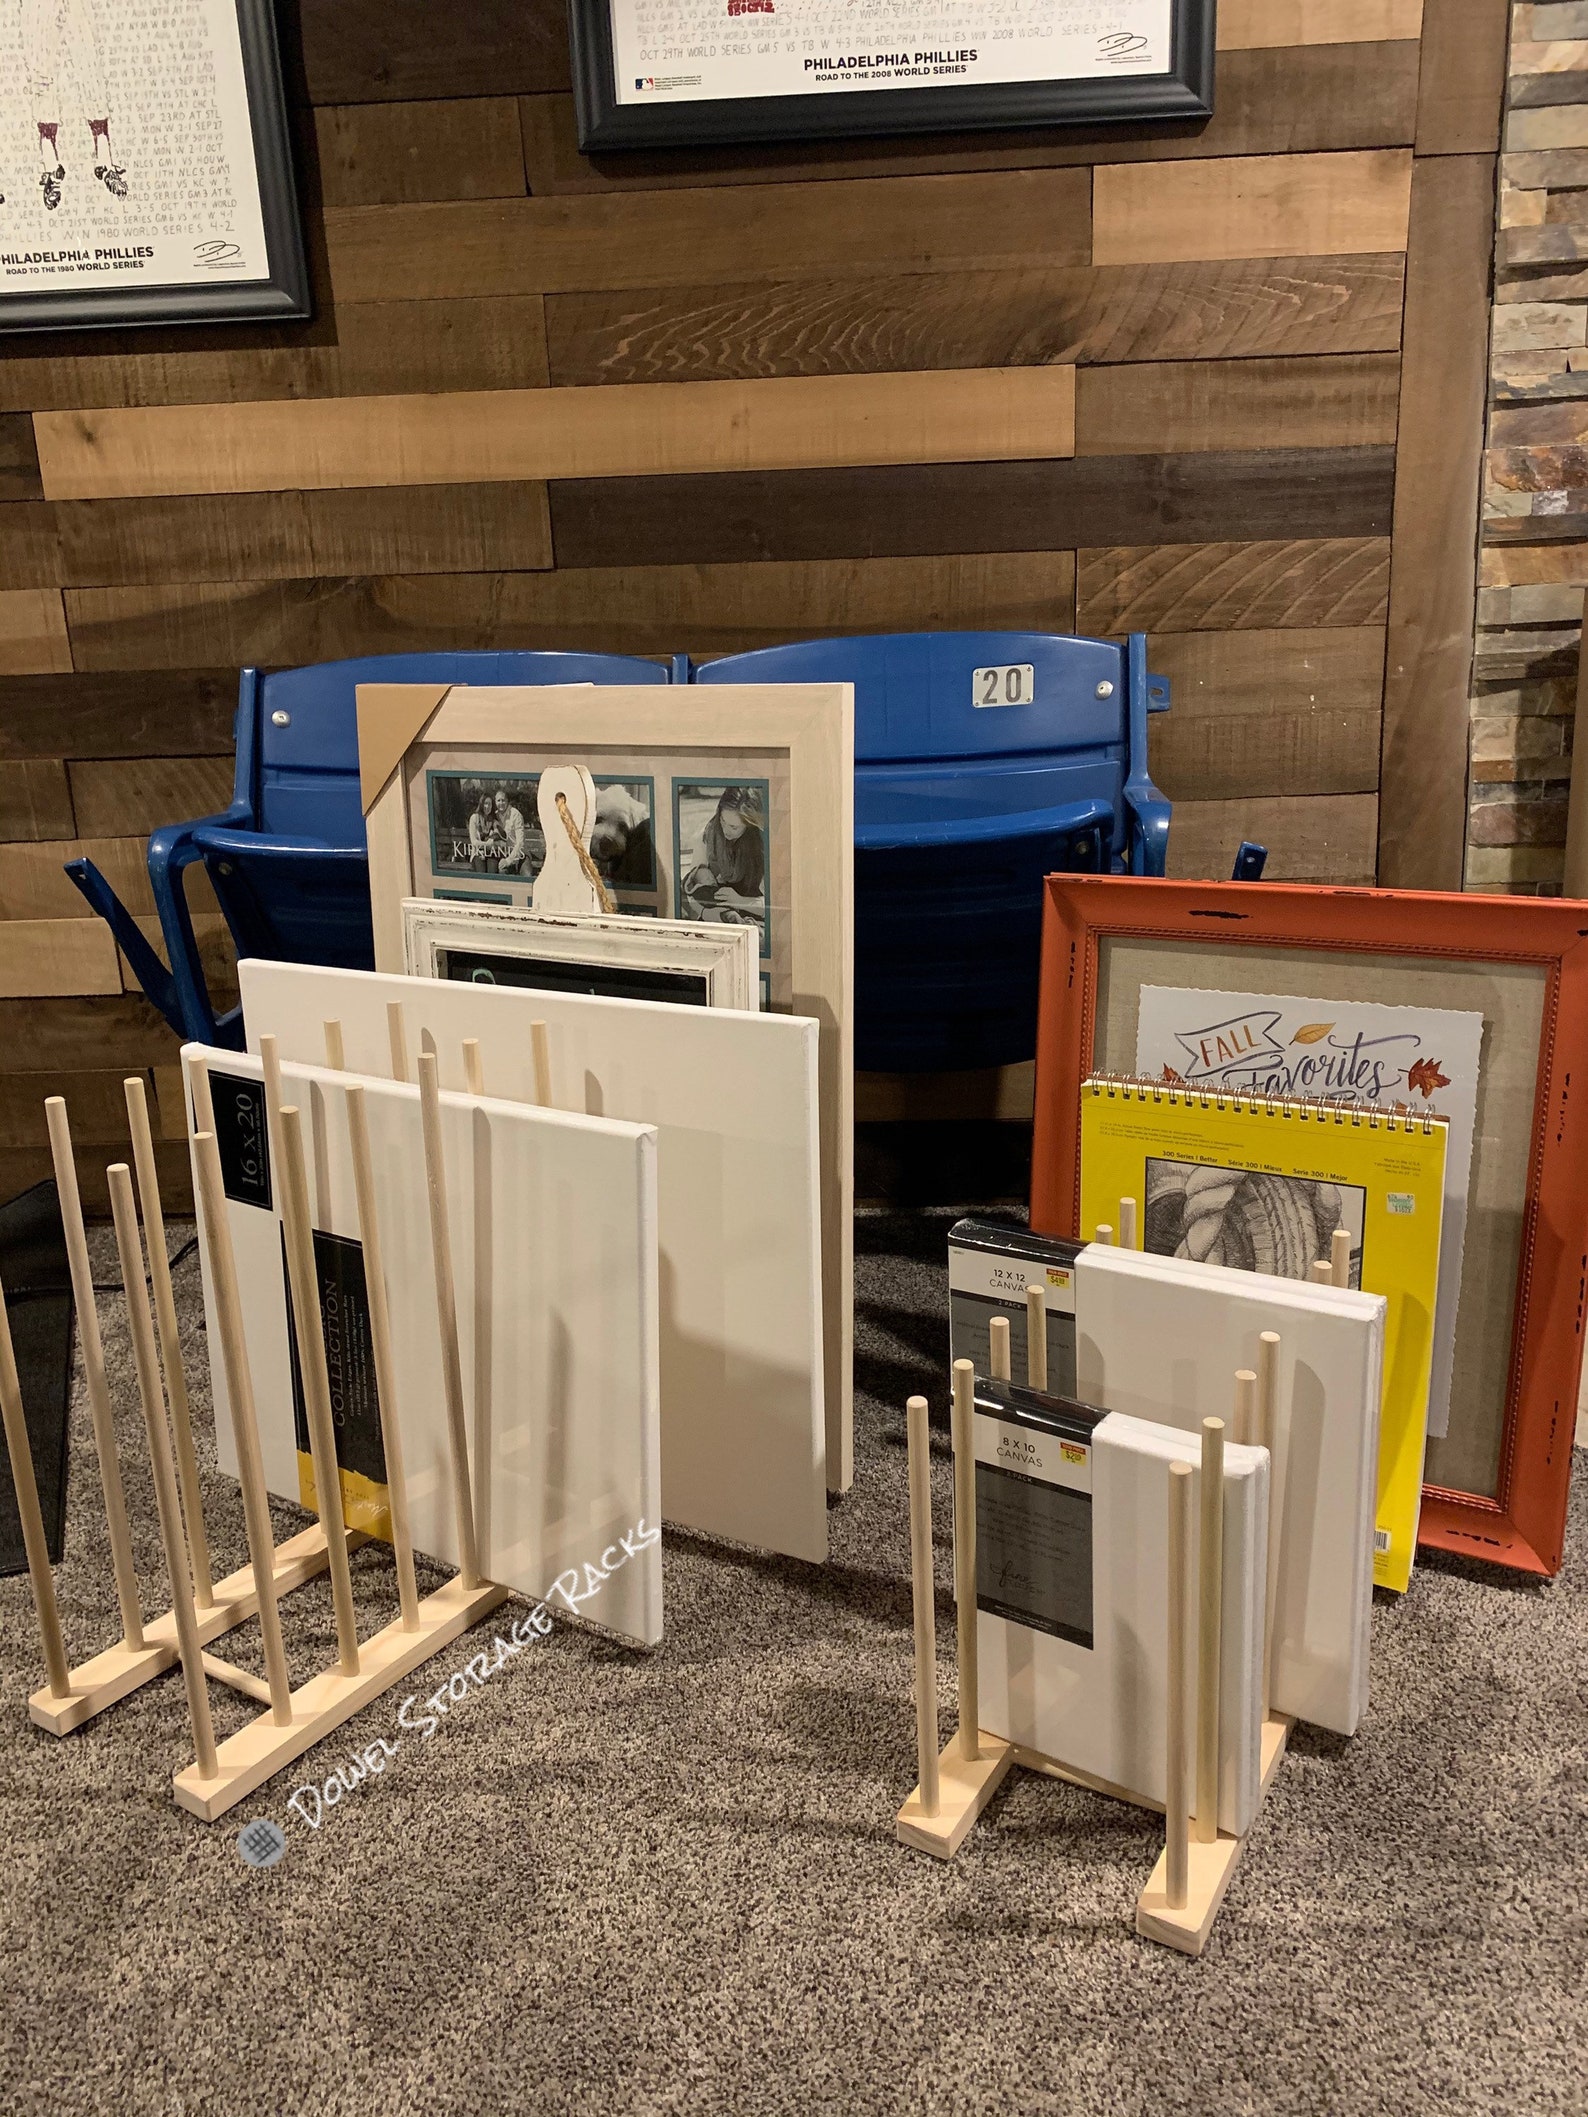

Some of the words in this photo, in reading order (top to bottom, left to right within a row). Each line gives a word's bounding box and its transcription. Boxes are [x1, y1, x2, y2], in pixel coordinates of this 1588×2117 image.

[639, 49, 659, 61] OCT
[662, 47, 684, 60] 29TH
[686, 45, 716, 59] WORLD
[721, 43, 751, 56] SERIES
[785, 41, 796, 53] VS
[855, 33, 918, 47] PHILADELPHIA
[922, 31, 967, 44] PHILLIES
[992, 28, 1014, 41] 2008
[804, 52, 911, 71] PHILADELPHIA
[914, 49, 979, 65] PHILLIES
[815, 72, 838, 82] ROAD
[840, 71, 852, 81] TO
[853, 70, 870, 80] THE
[871, 69, 892, 79] 2008
[894, 66, 931, 78] WORLD
[933, 64, 968, 75] SERIES
[178, 166, 205, 178] NLCS
[153, 190, 184, 201] SERIES
[211, 187, 224, 198] AT
[160, 200, 179, 212] OCT
[211, 198, 238, 210] WORLD
[90, 215, 120, 227] WORLD
[123, 213, 152, 225] SERIES
[63, 229, 91, 241] WIN
[96, 226, 120, 240] 1980
[123, 225, 159, 239] WORLD
[162, 223, 205, 237] SERIES
[209, 219, 236, 233] 4-2
[0, 250, 90, 265] HILADELPHIA
[94, 246, 155, 260] PHILLIES
[6, 267, 28, 276] ROAD
[29, 267, 40, 275] TO
[41, 265, 56, 274] THE
[57, 264, 75, 273] 1980
[76, 261, 111, 272] WORLD
[112, 260, 146, 270] SERIES
[982, 667, 1022, 705] 20
[452, 840, 526, 860] KIRKLANDS
[1199, 1023, 1262, 1068] FALL
[1222, 1031, 1421, 1100] Favorites
[236, 1093, 255, 1130] 20
[1162, 1150, 1175, 1158] 300
[1176, 1151, 1194, 1161] Series
[1200, 1155, 1218, 1164] Better
[240, 1158, 259, 1187] 16
[1245, 1161, 1259, 1170] 300
[1263, 1164, 1283, 1173] Mieux
[1292, 1168, 1309, 1177] Serie
[1311, 1170, 1324, 1179] 300
[1330, 1173, 1348, 1183] Mejor
[993, 1268, 1004, 1279] 12
[1006, 1271, 1014, 1281] X
[1015, 1272, 1026, 1284] 12
[989, 1278, 1029, 1293] CANVAS
[1004, 1301, 1021, 1309] PACK
[325, 1278, 346, 1427] COLLECTION
[1002, 1436, 1010, 1447] 8
[1013, 1440, 1020, 1450] X
[1024, 1442, 1036, 1454] 10
[996, 1447, 1043, 1468] CANVAS
[1013, 1473, 1033, 1484] PACK
